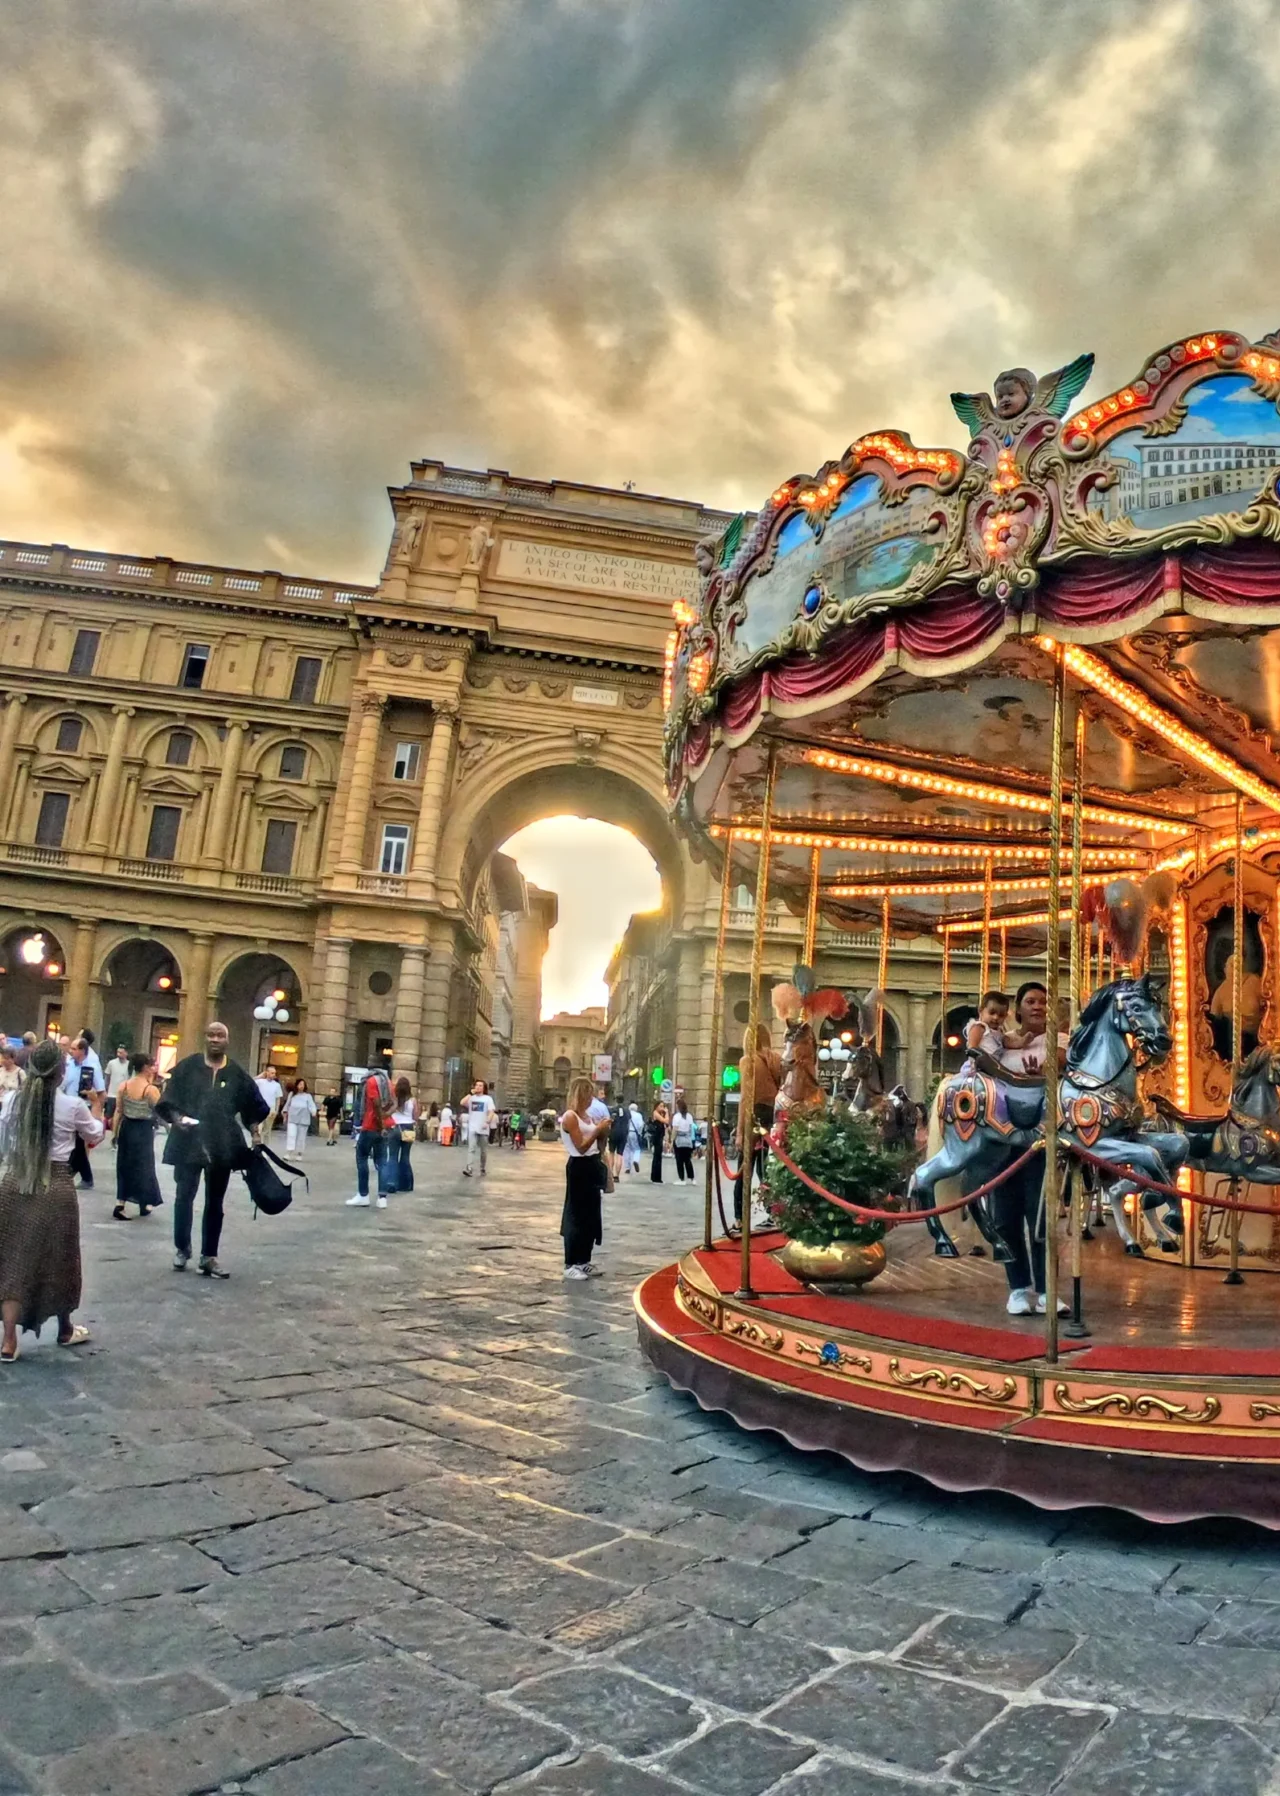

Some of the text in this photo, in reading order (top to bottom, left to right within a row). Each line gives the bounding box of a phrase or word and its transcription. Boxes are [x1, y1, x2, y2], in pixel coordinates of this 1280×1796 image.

[524, 545, 571, 560] ANTICO
[575, 552, 629, 568] CENTRO
[633, 560, 677, 576] DELLA
[525, 555, 542, 566] DA
[548, 559, 618, 577] SECOLARE
[538, 568, 567, 580] VITA
[573, 573, 617, 588] NUOVA
